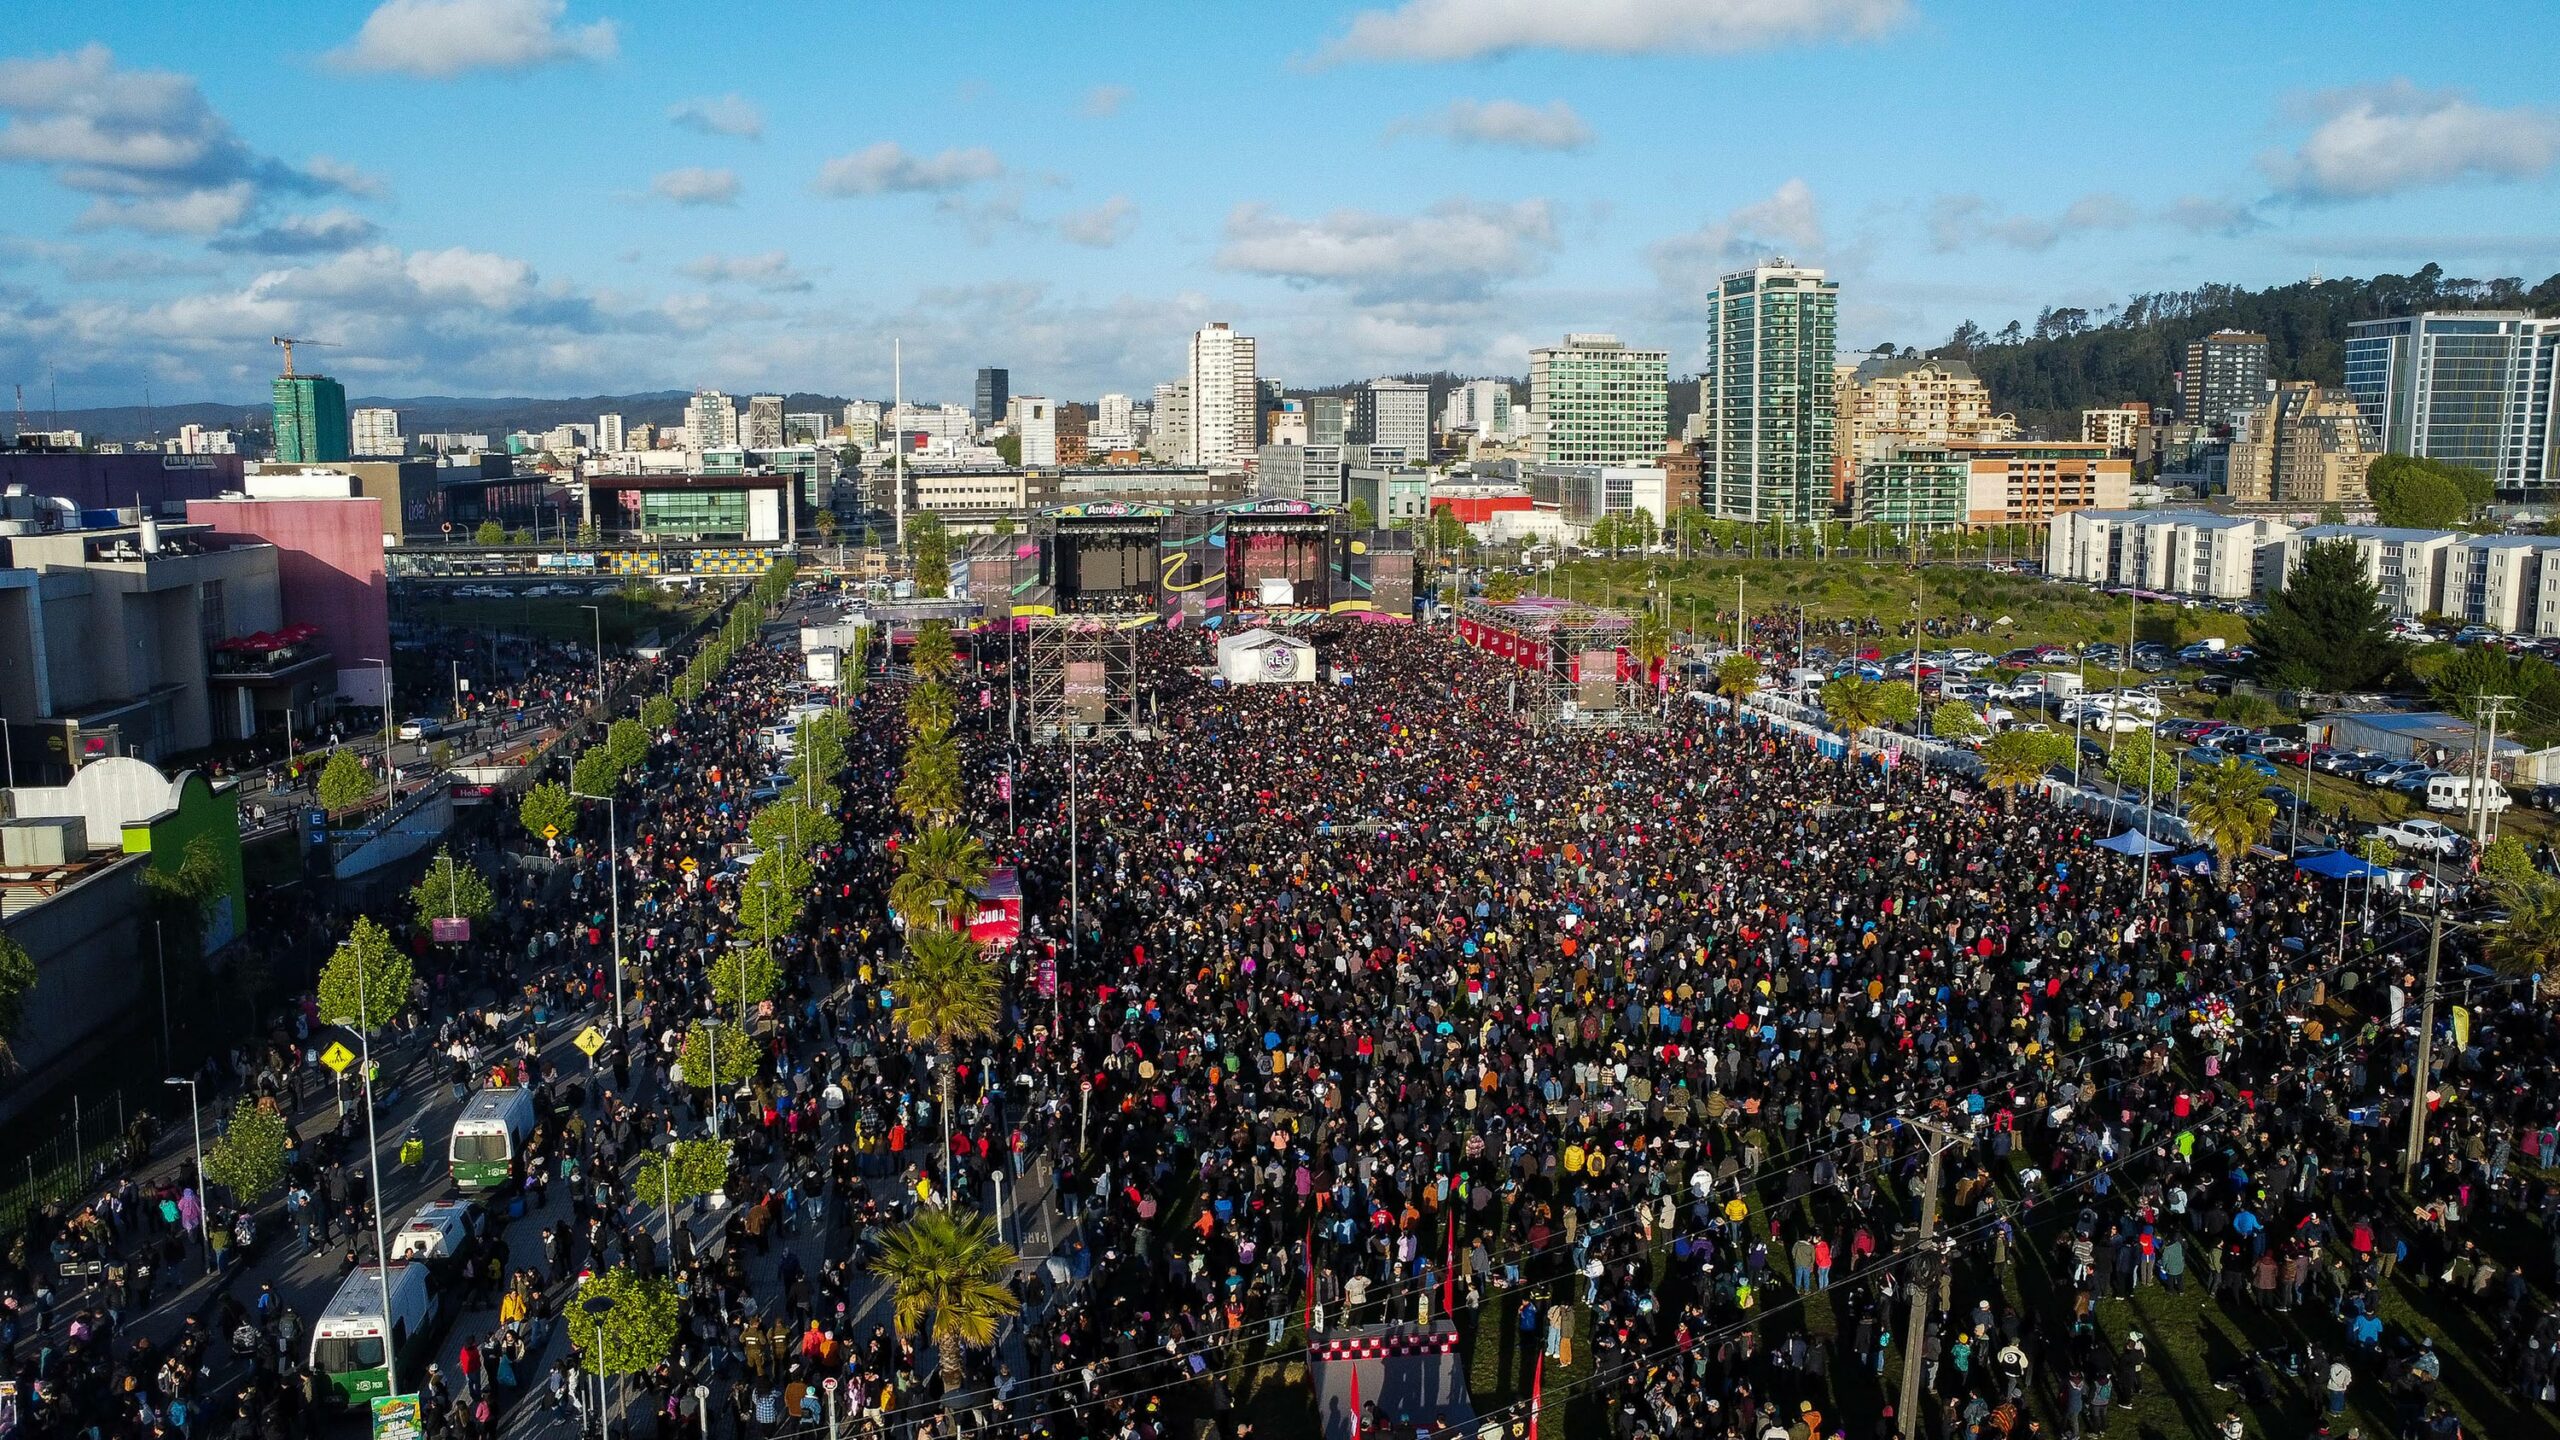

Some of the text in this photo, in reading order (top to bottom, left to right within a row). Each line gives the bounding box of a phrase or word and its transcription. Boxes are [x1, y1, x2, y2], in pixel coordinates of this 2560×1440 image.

[1087, 504, 1126, 516] Antuco
[1255, 502, 1303, 513] Lanalhue
[1267, 656, 1292, 665] REC
[312, 814, 322, 825] E
[1023, 1231, 1048, 1244] PARE
